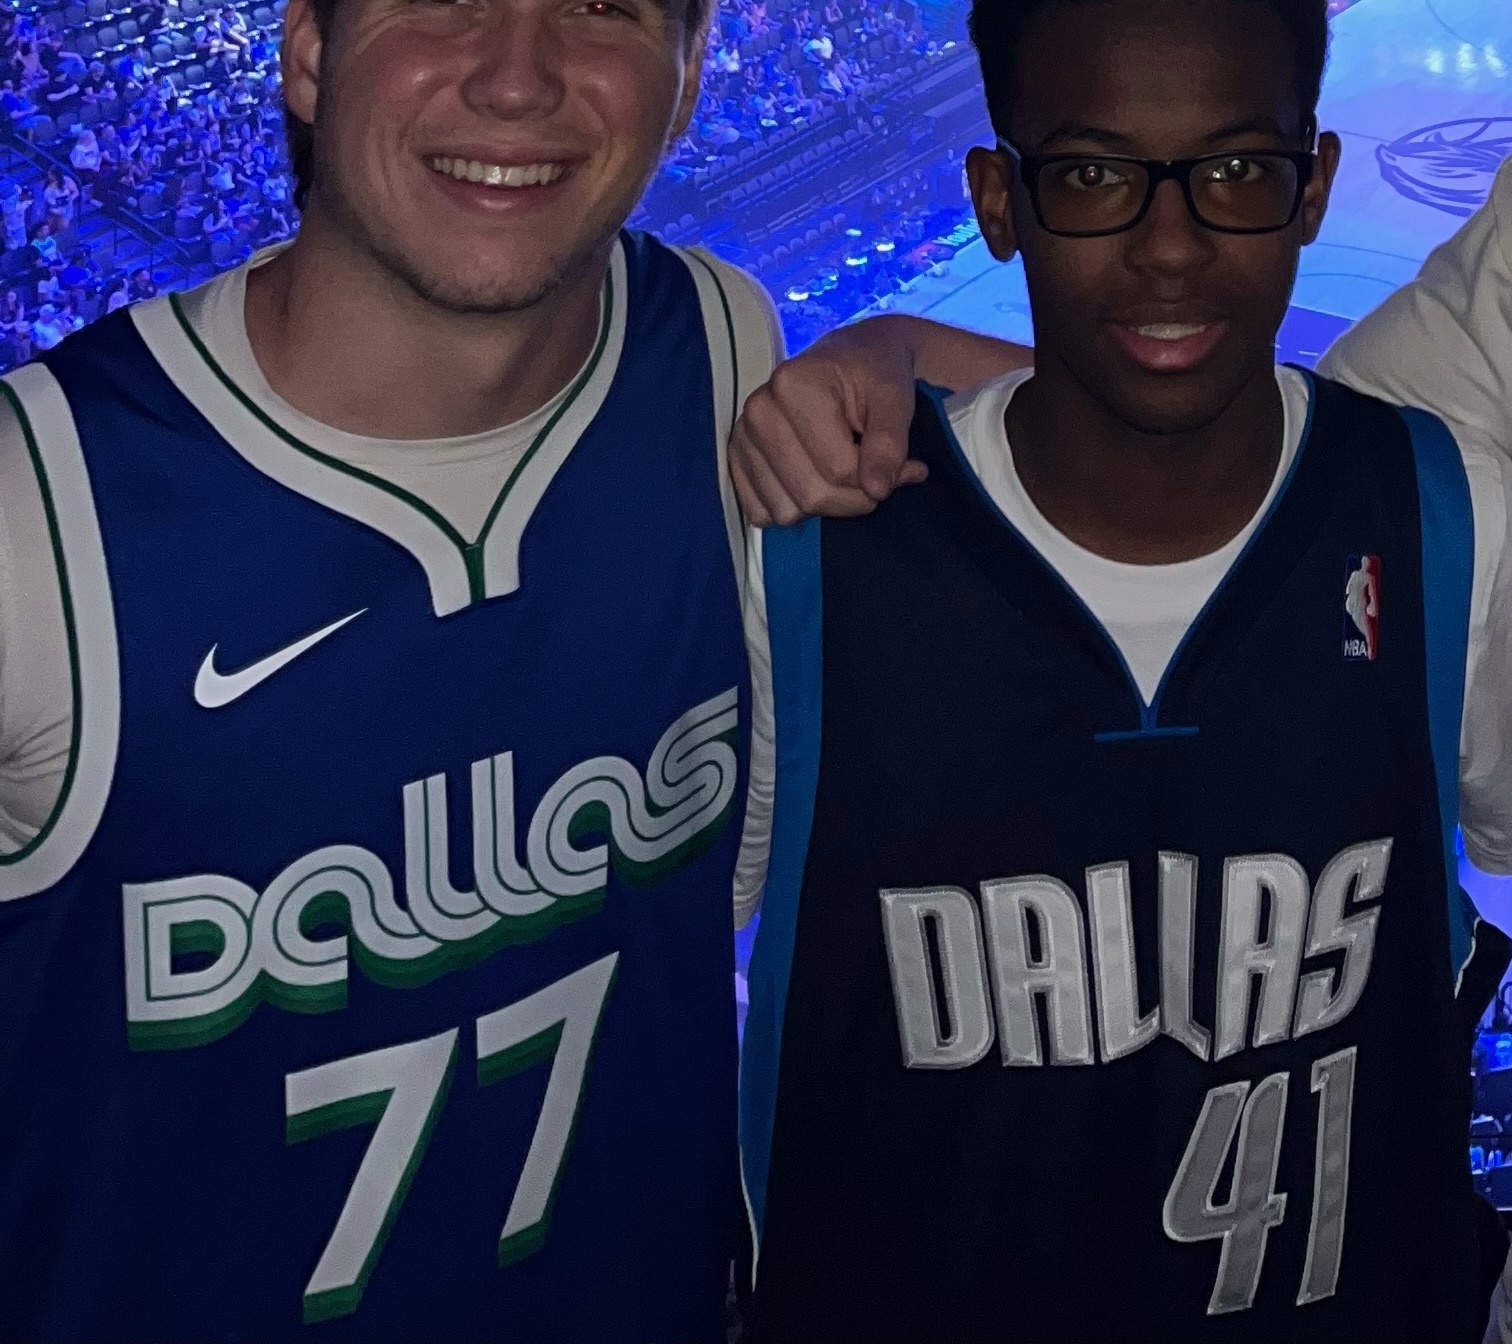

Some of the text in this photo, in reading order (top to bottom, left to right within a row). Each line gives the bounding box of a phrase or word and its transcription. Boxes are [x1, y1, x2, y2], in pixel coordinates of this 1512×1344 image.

[1344, 638, 1368, 657] NBA
[878, 835, 1395, 1070] DALLAS
[285, 949, 621, 1325] 77
[1162, 1043, 1357, 1317] 41
